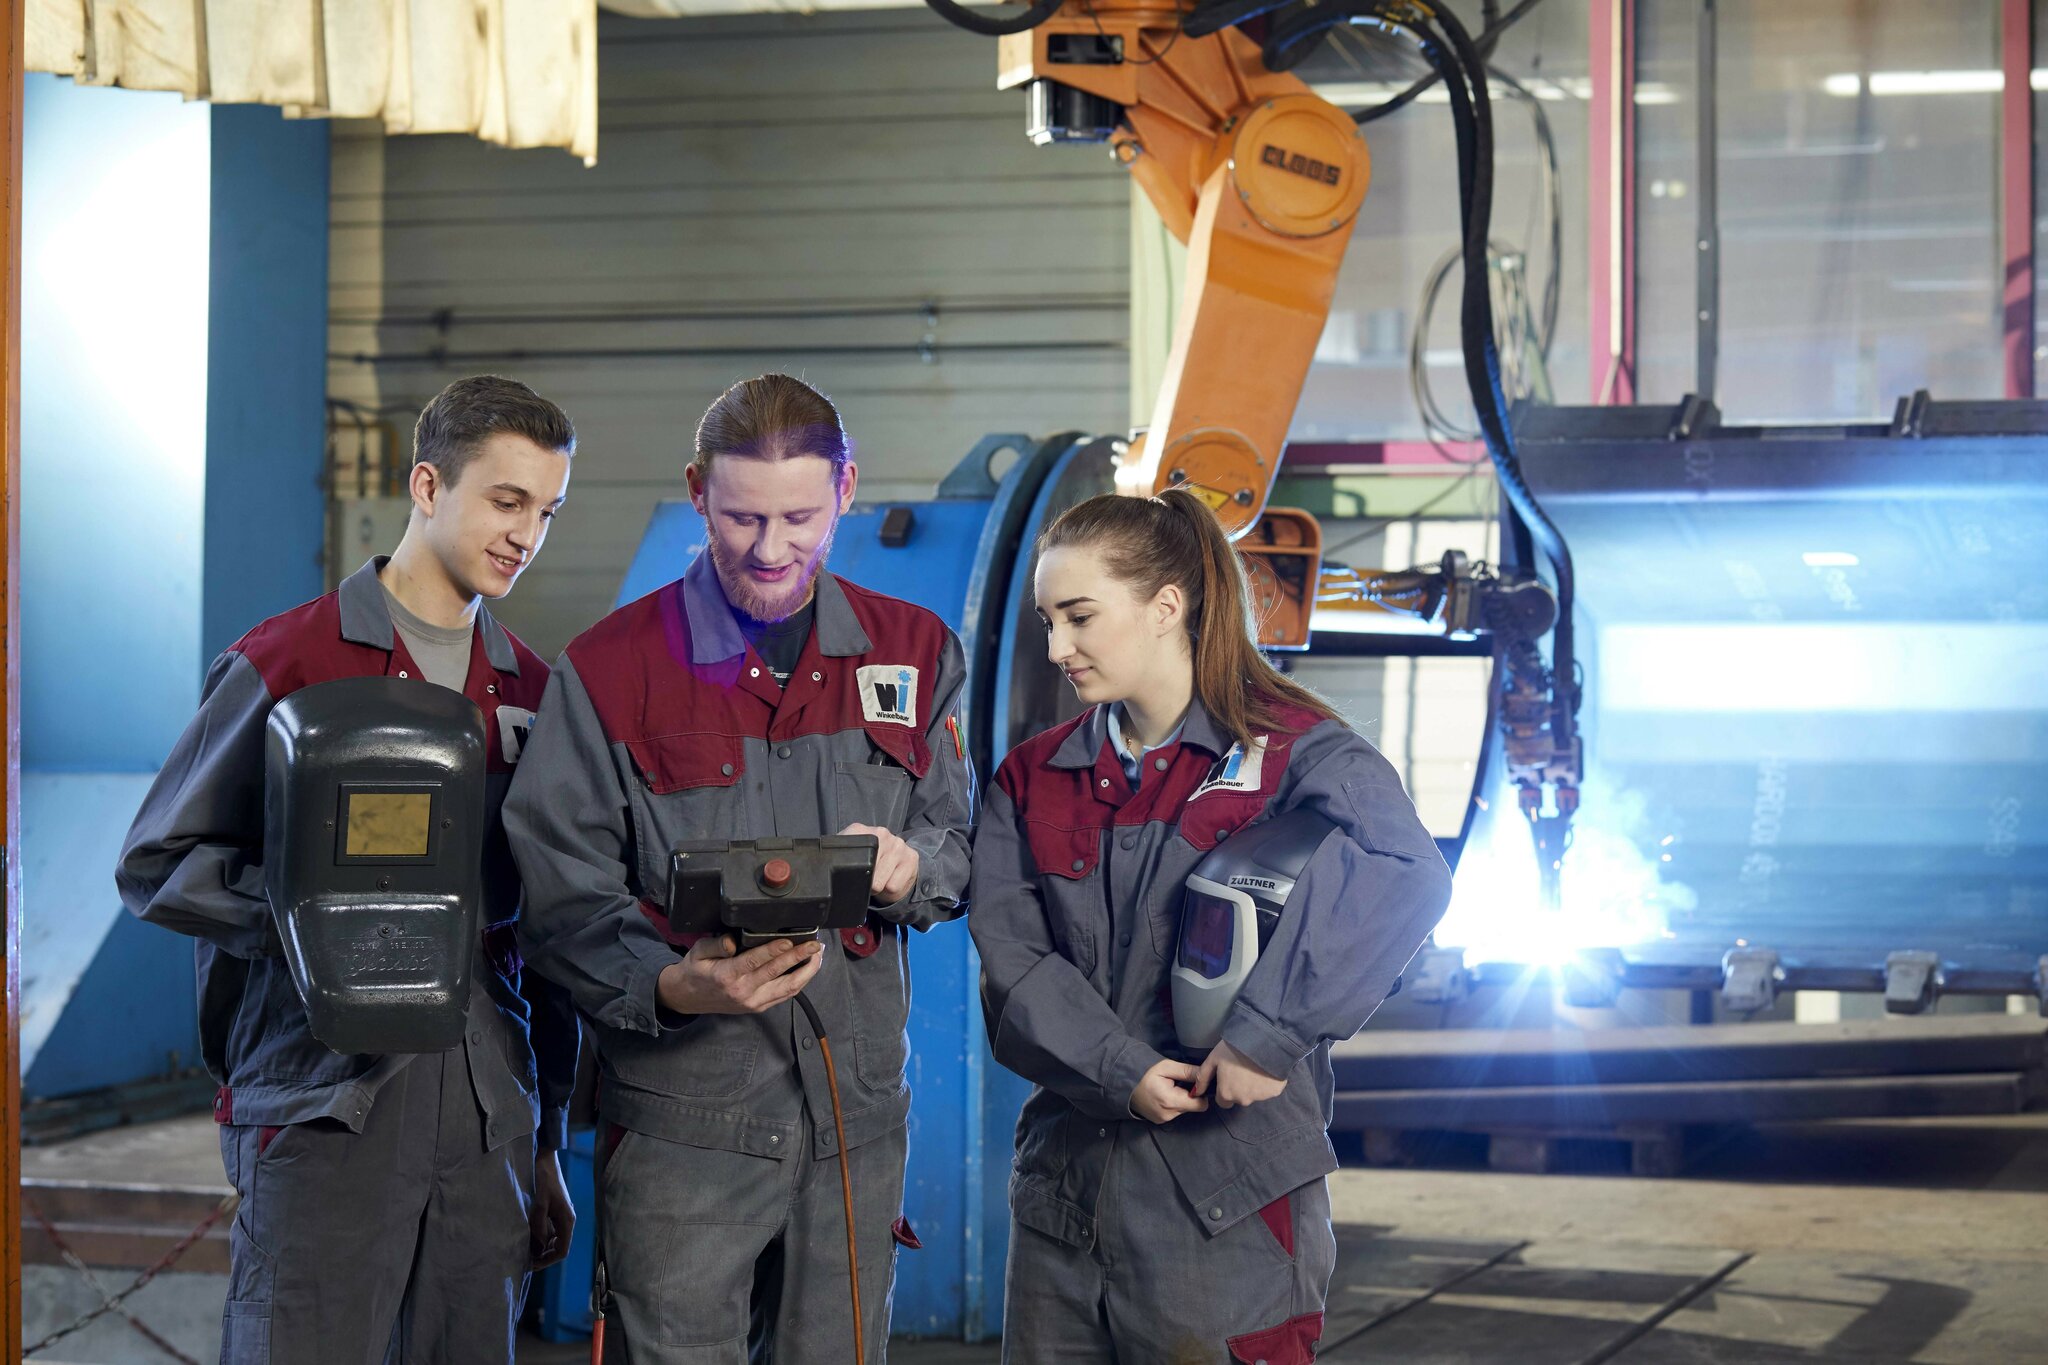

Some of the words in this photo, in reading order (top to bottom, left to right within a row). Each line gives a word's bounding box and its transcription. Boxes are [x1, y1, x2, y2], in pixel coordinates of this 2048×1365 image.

[1261, 144, 1341, 186] CLOOS
[876, 711, 909, 721] Winkelbauer
[1230, 877, 1276, 890] ZULTNER
